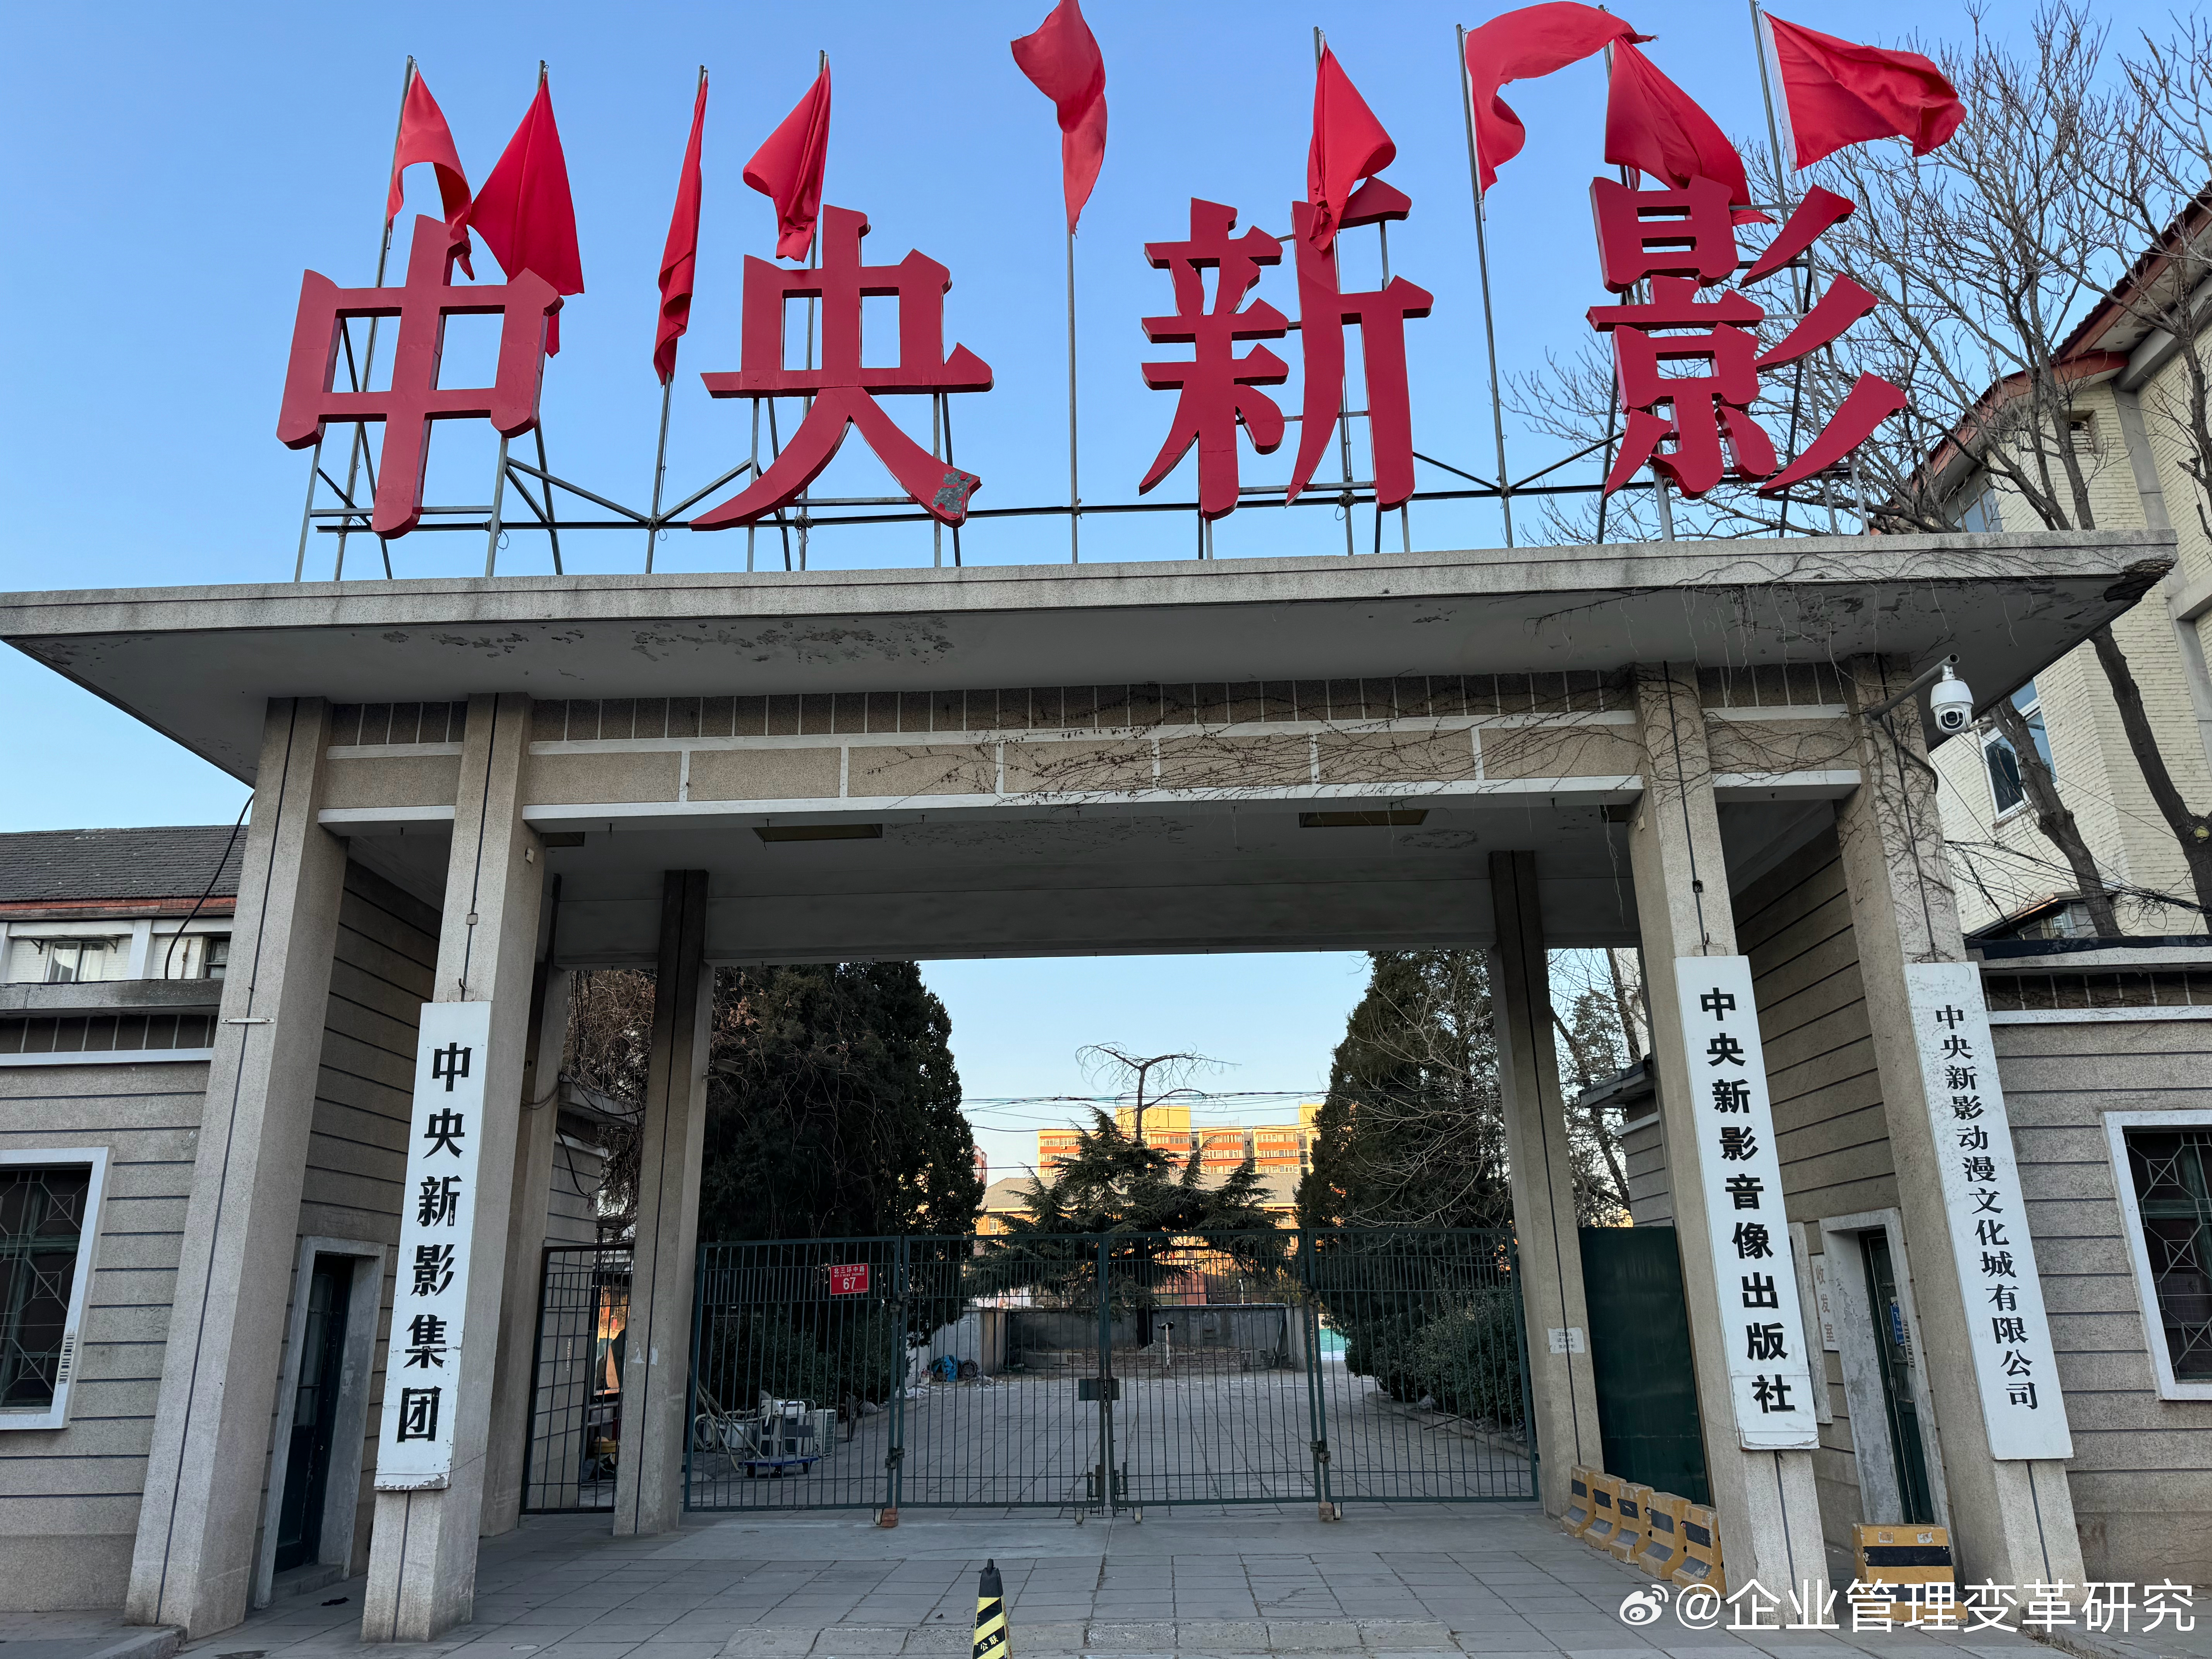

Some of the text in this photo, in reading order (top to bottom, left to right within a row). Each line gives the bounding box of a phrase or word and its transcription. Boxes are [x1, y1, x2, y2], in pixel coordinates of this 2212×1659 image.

[276, 174, 1907, 539] 中央新影
[396, 1042, 472, 1444] 中央新影集团
[843, 1277, 856, 1290] 67
[1700, 987, 1796, 1414] 中央新影音像出版社
[1816, 1265, 1835, 1342] 收发室
[1935, 1004, 2039, 1410] 中央新影动漫文化城有限公司
[980, 1634, 999, 1652] 公联
